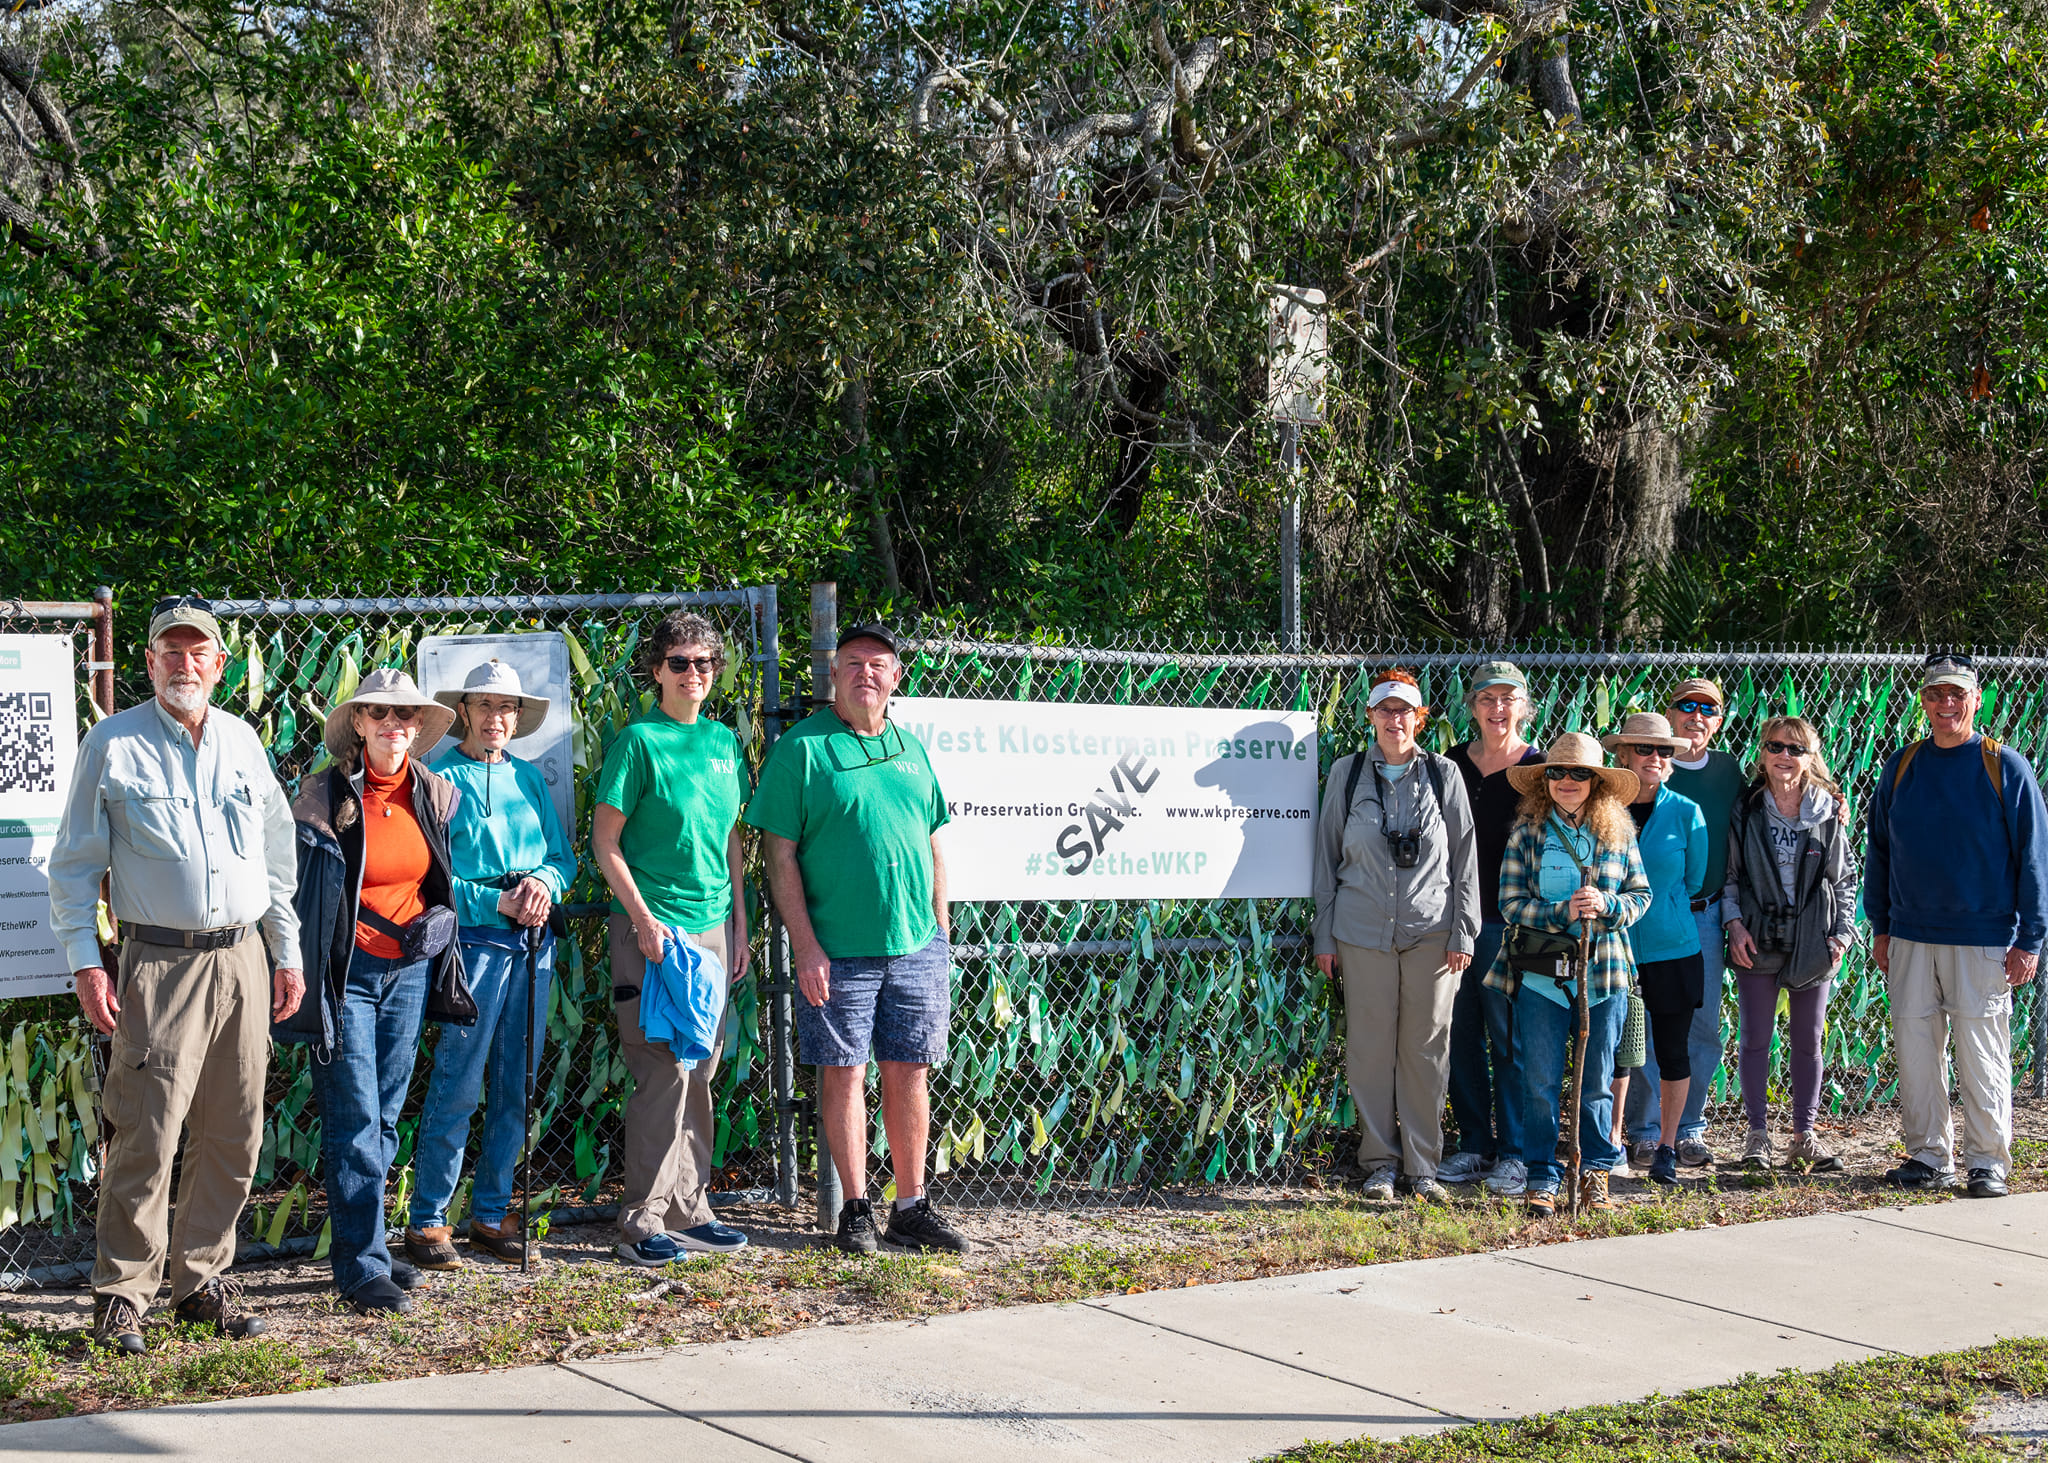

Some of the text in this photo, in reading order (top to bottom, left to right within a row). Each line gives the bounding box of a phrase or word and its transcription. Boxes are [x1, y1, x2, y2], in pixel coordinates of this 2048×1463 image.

[903, 721, 1308, 761] West Klosterman Preserve
[710, 758, 735, 774] WKP
[893, 761, 919, 775] WKP
[947, 801, 1143, 817] K Preservation Grp Ic.
[1056, 748, 1161, 876] SAVE
[1166, 804, 1311, 821] www.wkpreserve.com
[0, 822, 60, 835] ur community
[0, 856, 46, 866] serve.com
